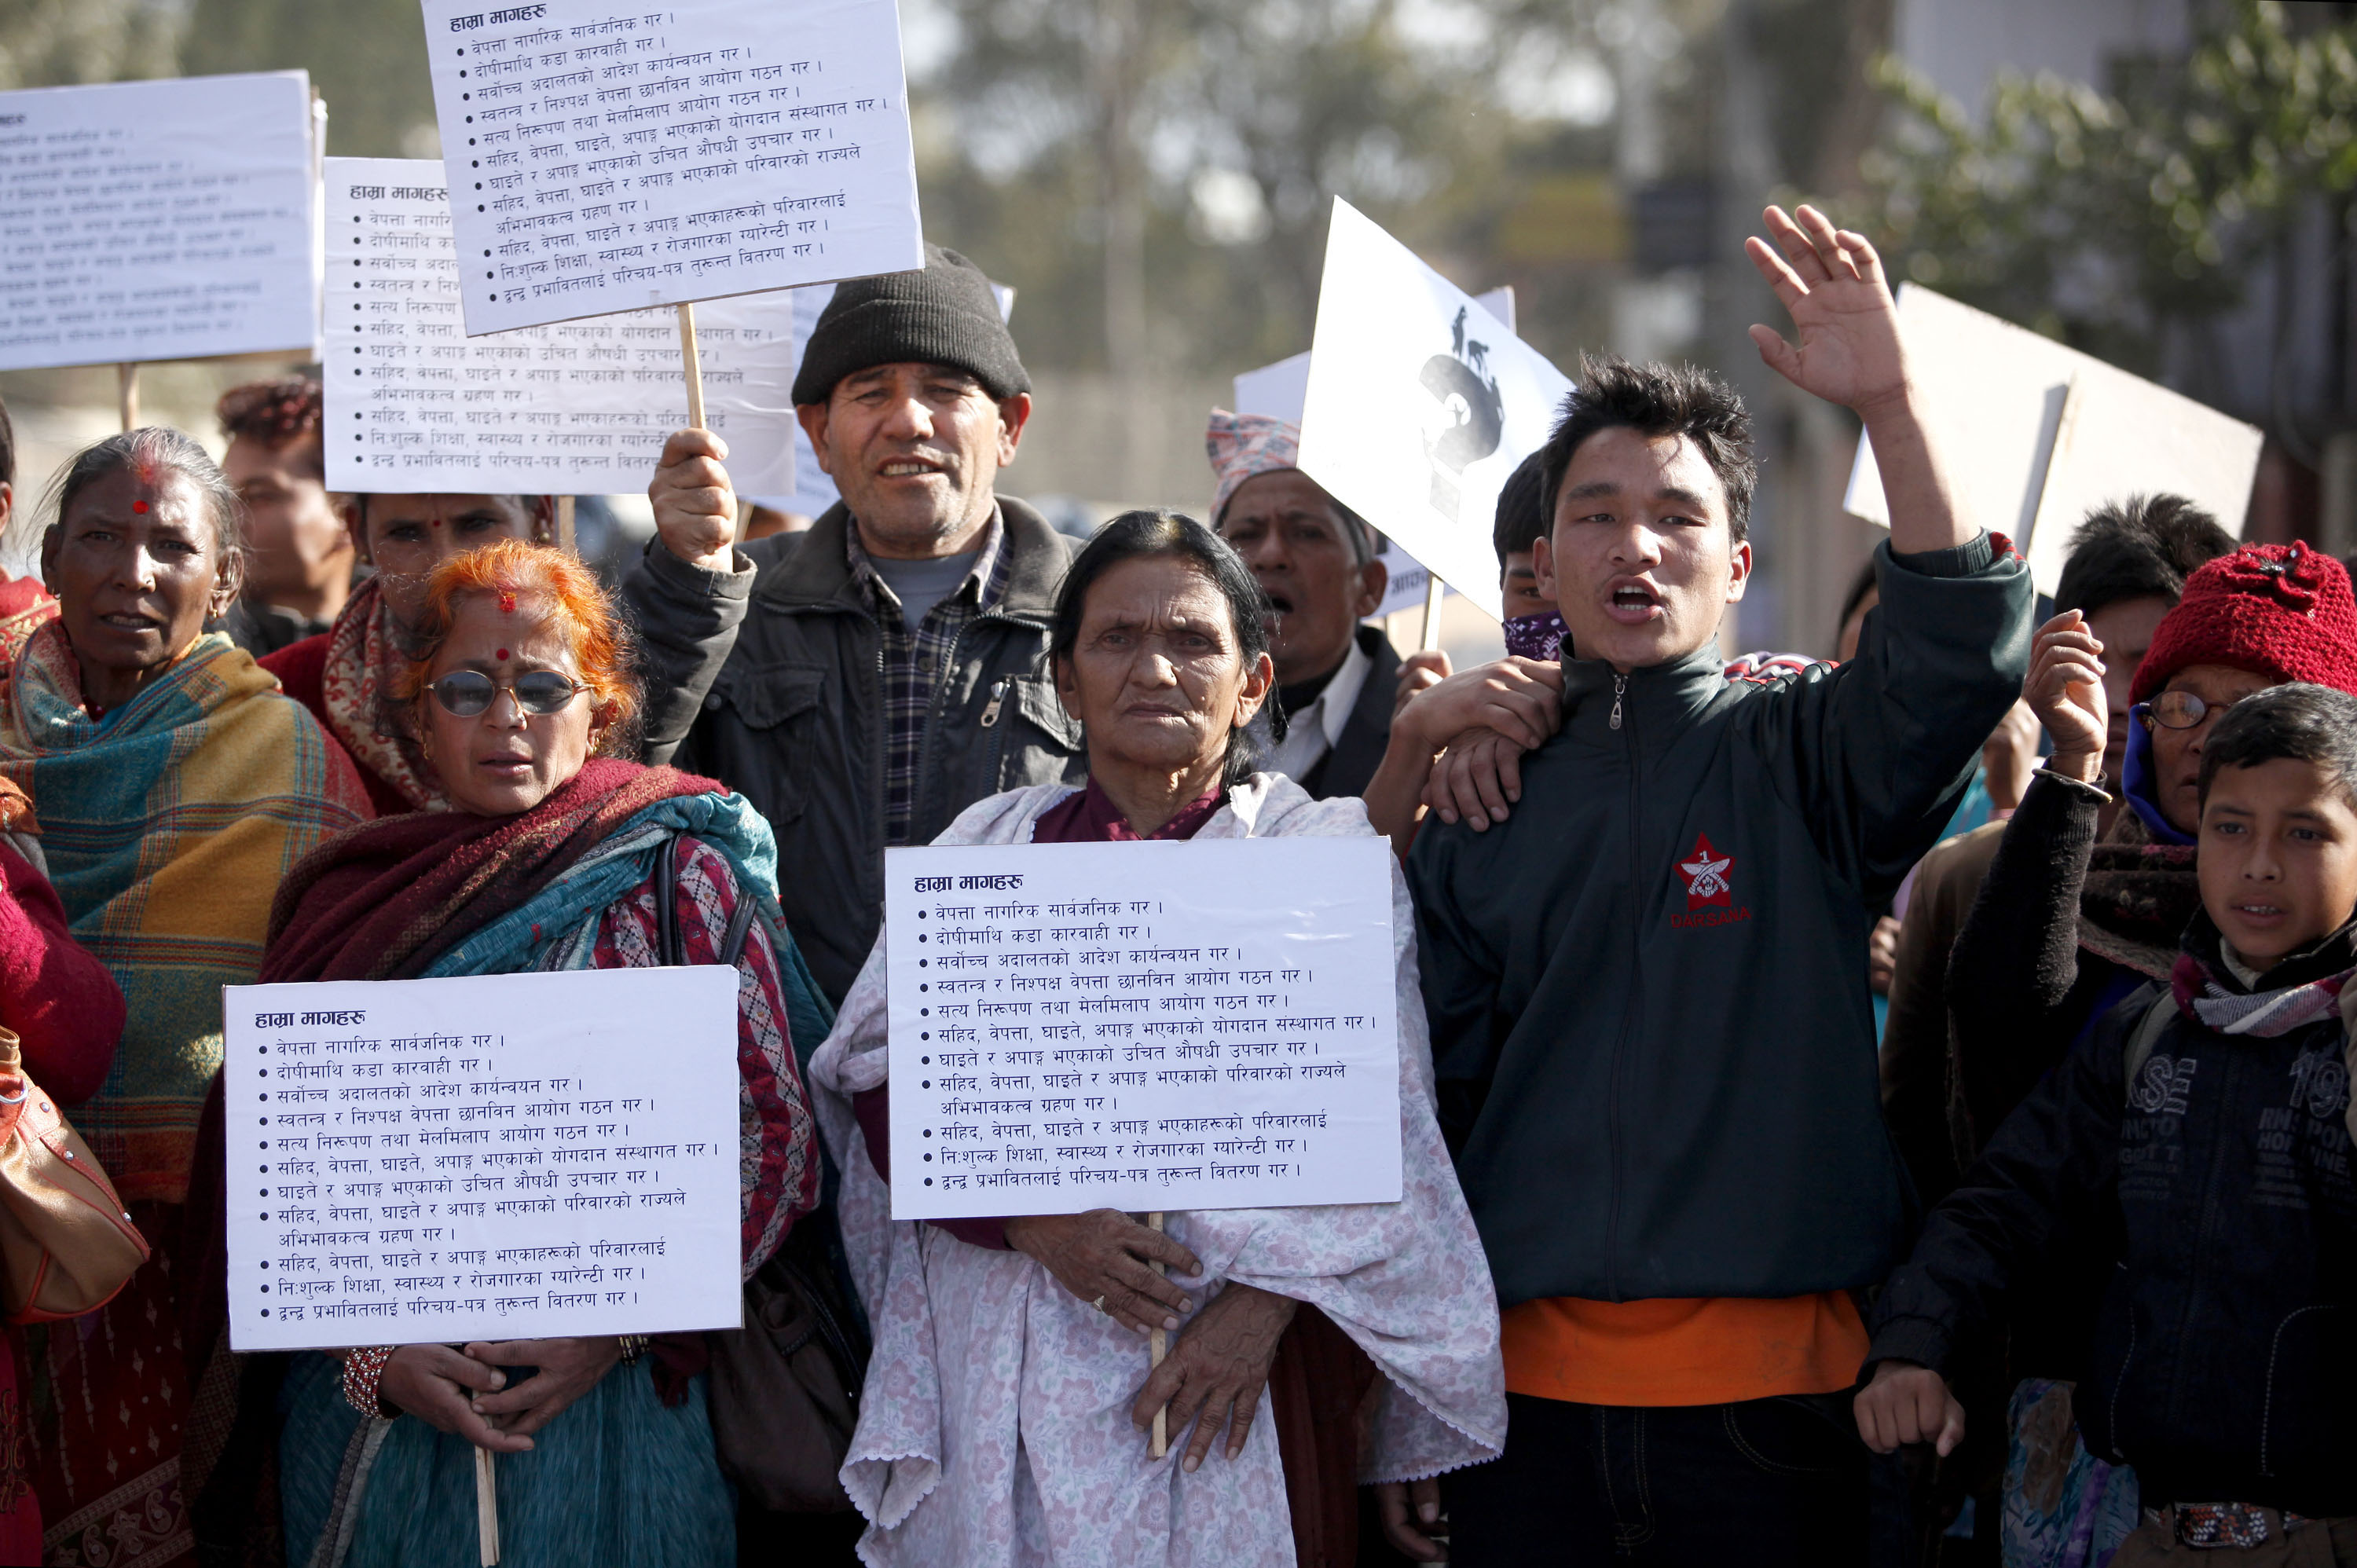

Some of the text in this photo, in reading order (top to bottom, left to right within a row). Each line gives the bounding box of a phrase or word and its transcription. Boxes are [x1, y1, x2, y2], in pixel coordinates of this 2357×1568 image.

[449, 13, 484, 32] हाम्रा
[471, 38, 507, 55] वेपत्ता
[512, 27, 563, 48] नागरिक
[569, 16, 637, 38] सार्वजनिक
[643, 13, 663, 27] गर
[479, 104, 523, 121] स्वतन्त्र
[529, 101, 538, 112] र
[595, 86, 632, 103] वेपत्ता
[698, 68, 742, 86] आयोग
[748, 64, 783, 80] गठन
[789, 60, 810, 75] गर
[491, 193, 529, 211] सहिद,
[534, 188, 574, 204] वेपत्ता,
[579, 177, 615, 197] घाइते
[621, 178, 631, 188] र
[680, 158, 738, 182] भएकाको
[744, 148, 809, 172] परिवारको
[816, 141, 861, 162] राज्यले
[497, 238, 534, 256] सहिद,
[540, 233, 579, 249] वेपत्ता,
[585, 222, 621, 241] घाइते
[627, 222, 636, 233] र
[772, 188, 846, 214] परिवारलाई
[913, 876, 954, 893] हाम्रा
[934, 902, 976, 921] वेपत्ता
[982, 899, 1039, 920] नागरिक
[1047, 896, 1122, 918] सार्वजनिक
[1128, 900, 1150, 914] गर
[1670, 906, 1751, 929] DARSANA
[934, 925, 1003, 946] दोषीमाथि
[1010, 928, 1043, 943] कडा
[1049, 921, 1110, 942] कारवाही
[1116, 925, 1139, 940] गर
[997, 947, 1070, 968] अदालतको
[1078, 946, 1121, 965] आदेश
[1207, 947, 1230, 962] गर
[936, 979, 987, 995] स्वतन्त्र
[993, 978, 1003, 992] र
[1069, 971, 1110, 990] वेपत्ता
[1183, 967, 1230, 987] आयोग
[1237, 969, 1273, 984] गठन
[1279, 969, 1301, 984] गर
[255, 1012, 295, 1028] हाम्रा
[937, 1023, 981, 1046] सहिद,
[988, 1022, 1032, 1044] वेपत्ता,
[1040, 1020, 1085, 1042] घाइते,
[1141, 1016, 1204, 1039] भएकाको
[1211, 1015, 1268, 1034] योगदान
[1274, 1014, 1336, 1032] संस्थागत
[1343, 1015, 1364, 1030] गर
[938, 1072, 981, 1094] सहिद,
[988, 1071, 1035, 1093] वेपत्ता,
[1042, 1068, 1083, 1090] घाइते
[1090, 1072, 1100, 1086] र
[1155, 1064, 1219, 1087] भएकाको
[1225, 1061, 1293, 1083] परिवारको
[1299, 1060, 1347, 1079] राज्यले
[2125, 1053, 2198, 1116] SE
[2288, 1051, 2349, 1119] 19
[276, 1137, 310, 1152] सत्य
[379, 1133, 411, 1148] तथा
[417, 1126, 490, 1145] मेलमिलाप
[498, 1123, 546, 1142] आयोग
[552, 1124, 588, 1140] गठन
[595, 1123, 617, 1138] गर
[939, 1120, 983, 1143] सहिद,
[990, 1119, 1036, 1141] वेपत्ता,
[1043, 1116, 1085, 1138] घाइते
[1091, 1121, 1102, 1135] र
[1250, 1108, 1327, 1130] परिवारलाई
[276, 1180, 318, 1201] घाइते
[324, 1184, 335, 1197] र
[390, 1174, 453, 1198] भएकाको
[460, 1172, 505, 1192] उचित
[513, 1169, 559, 1189] औषधी
[566, 1171, 618, 1187] उपचार
[625, 1170, 647, 1184] गर
[940, 1174, 968, 1190] द्वन्द्व
[974, 1165, 1061, 1188] प्रभावितलाई
[1068, 1164, 1149, 1185] परिचय-पत्र
[1209, 1160, 1261, 1180] वितरण
[1267, 1163, 1288, 1178] गर
[276, 1203, 320, 1225] सहिद,
[328, 1203, 372, 1224] वेपत्ता,
[380, 1200, 422, 1221] घाइते
[427, 1203, 438, 1218] र
[493, 1193, 557, 1217] भएकाको
[563, 1190, 632, 1211] परिवारको
[639, 1187, 687, 1207] राज्यले
[278, 1228, 371, 1247] अभिभावकत्व
[377, 1228, 414, 1244] ग्रहण
[420, 1227, 443, 1242] गर
[342, 1274, 385, 1295] शिक्षा,
[393, 1276, 445, 1291] स्वास्थ्य
[452, 1274, 462, 1288] र
[468, 1269, 543, 1288] रोजगारका
[549, 1263, 605, 1284] ग्यारेन्टी
[611, 1266, 633, 1281] गर
